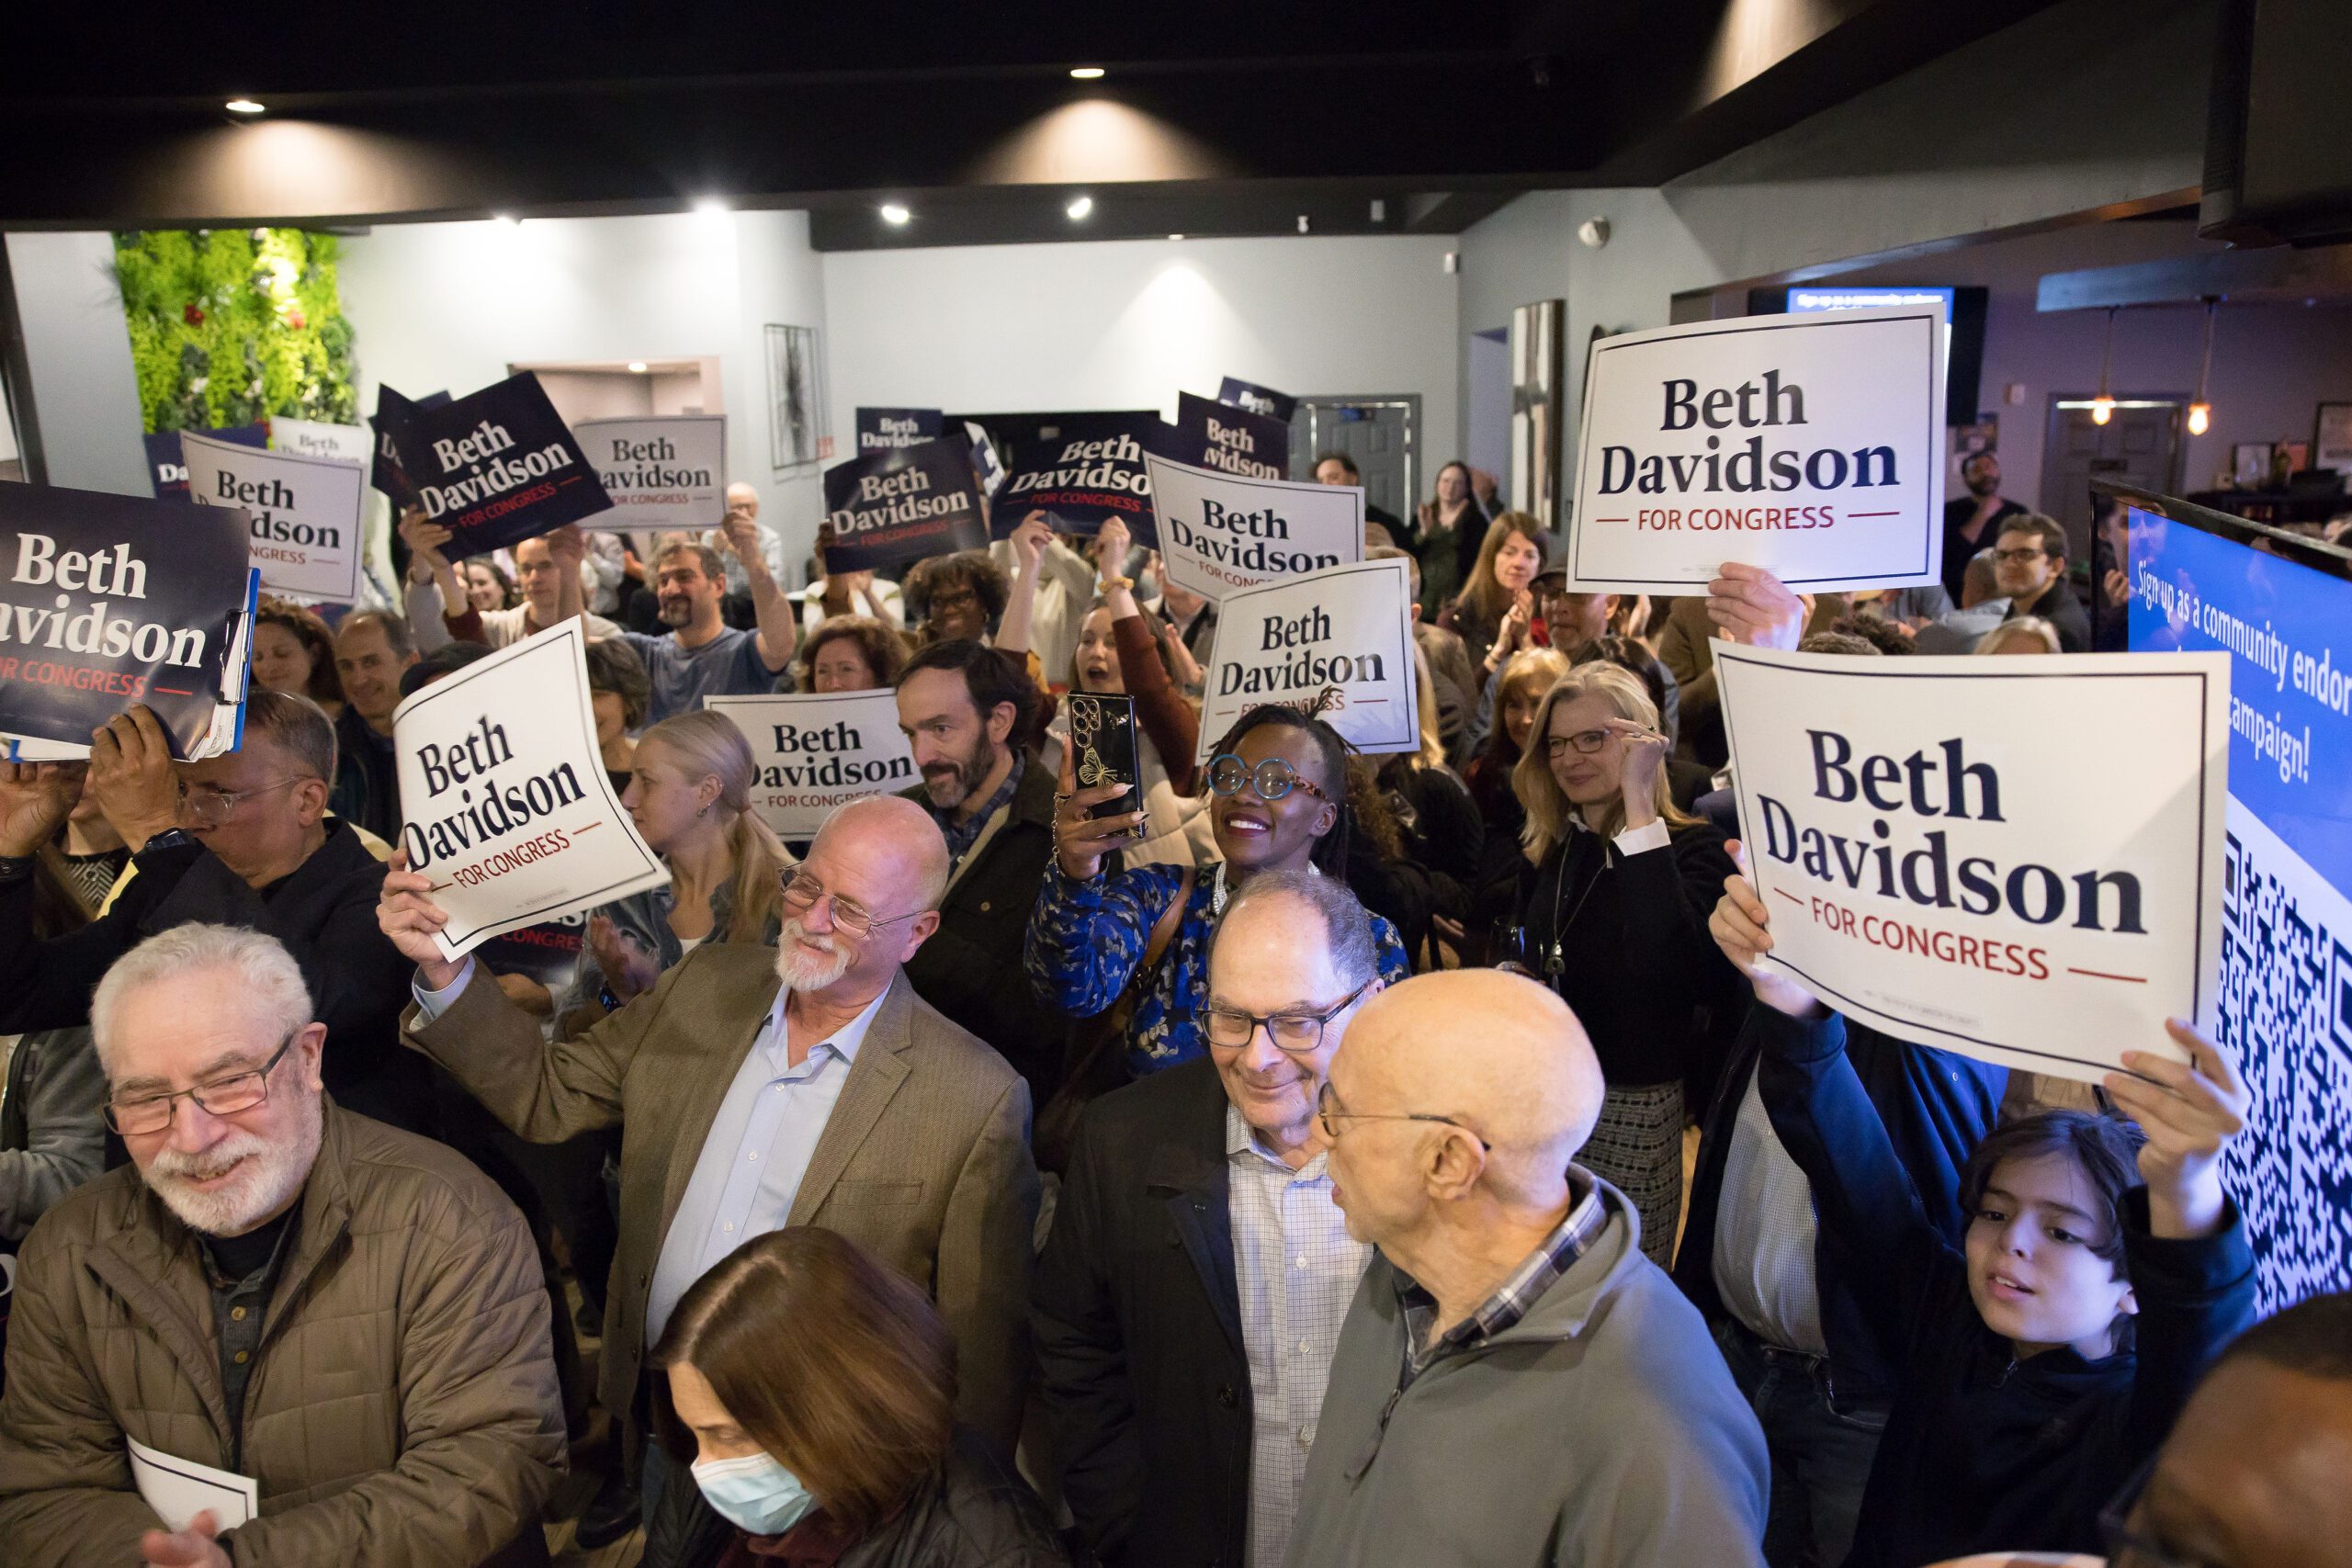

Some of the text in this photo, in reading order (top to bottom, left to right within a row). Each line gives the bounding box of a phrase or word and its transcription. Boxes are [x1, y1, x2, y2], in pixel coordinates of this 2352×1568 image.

[1660, 368, 1808, 432] Beth
[432, 420, 515, 473] Beth
[880, 417, 919, 434] Beth
[1207, 417, 1254, 453] Beth
[611, 437, 675, 462] Beth
[1057, 434, 1140, 463] Beth
[1598, 435, 1900, 495] Davidson
[217, 470, 295, 510] Beth
[419, 442, 574, 519] Davidson
[594, 464, 711, 490] avidson
[859, 466, 930, 502] Beth
[1008, 460, 1150, 496] Davidso
[458, 481, 557, 528] FOR CONGRESS
[831, 491, 969, 535] Davidson
[1030, 492, 1141, 513] FOR CONGRESS
[1201, 499, 1289, 540] Beth
[1638, 505, 1835, 531] FOR CONGRESS
[11, 533, 146, 599] Beth
[1170, 517, 1339, 573] Davidson
[1199, 561, 1222, 581] FOR
[1261, 604, 1331, 650] Beth
[2138, 560, 2158, 611] Sign
[2161, 578, 2175, 623] up
[2177, 588, 2190, 623] as
[2192, 597, 2200, 629] a
[2203, 602, 2289, 693] community
[21, 660, 149, 698] CONGRESS
[1218, 649, 1386, 696] Davidson
[416, 712, 514, 799] Beth
[773, 721, 863, 753] Beth
[1805, 729, 2007, 824] Beth
[404, 761, 586, 874] Davidson
[768, 795, 797, 808] FOR
[452, 829, 571, 889] FOR CONGRESS
[1757, 794, 2150, 936] Davidson
[1811, 896, 2051, 982] FOR CONGRESS
